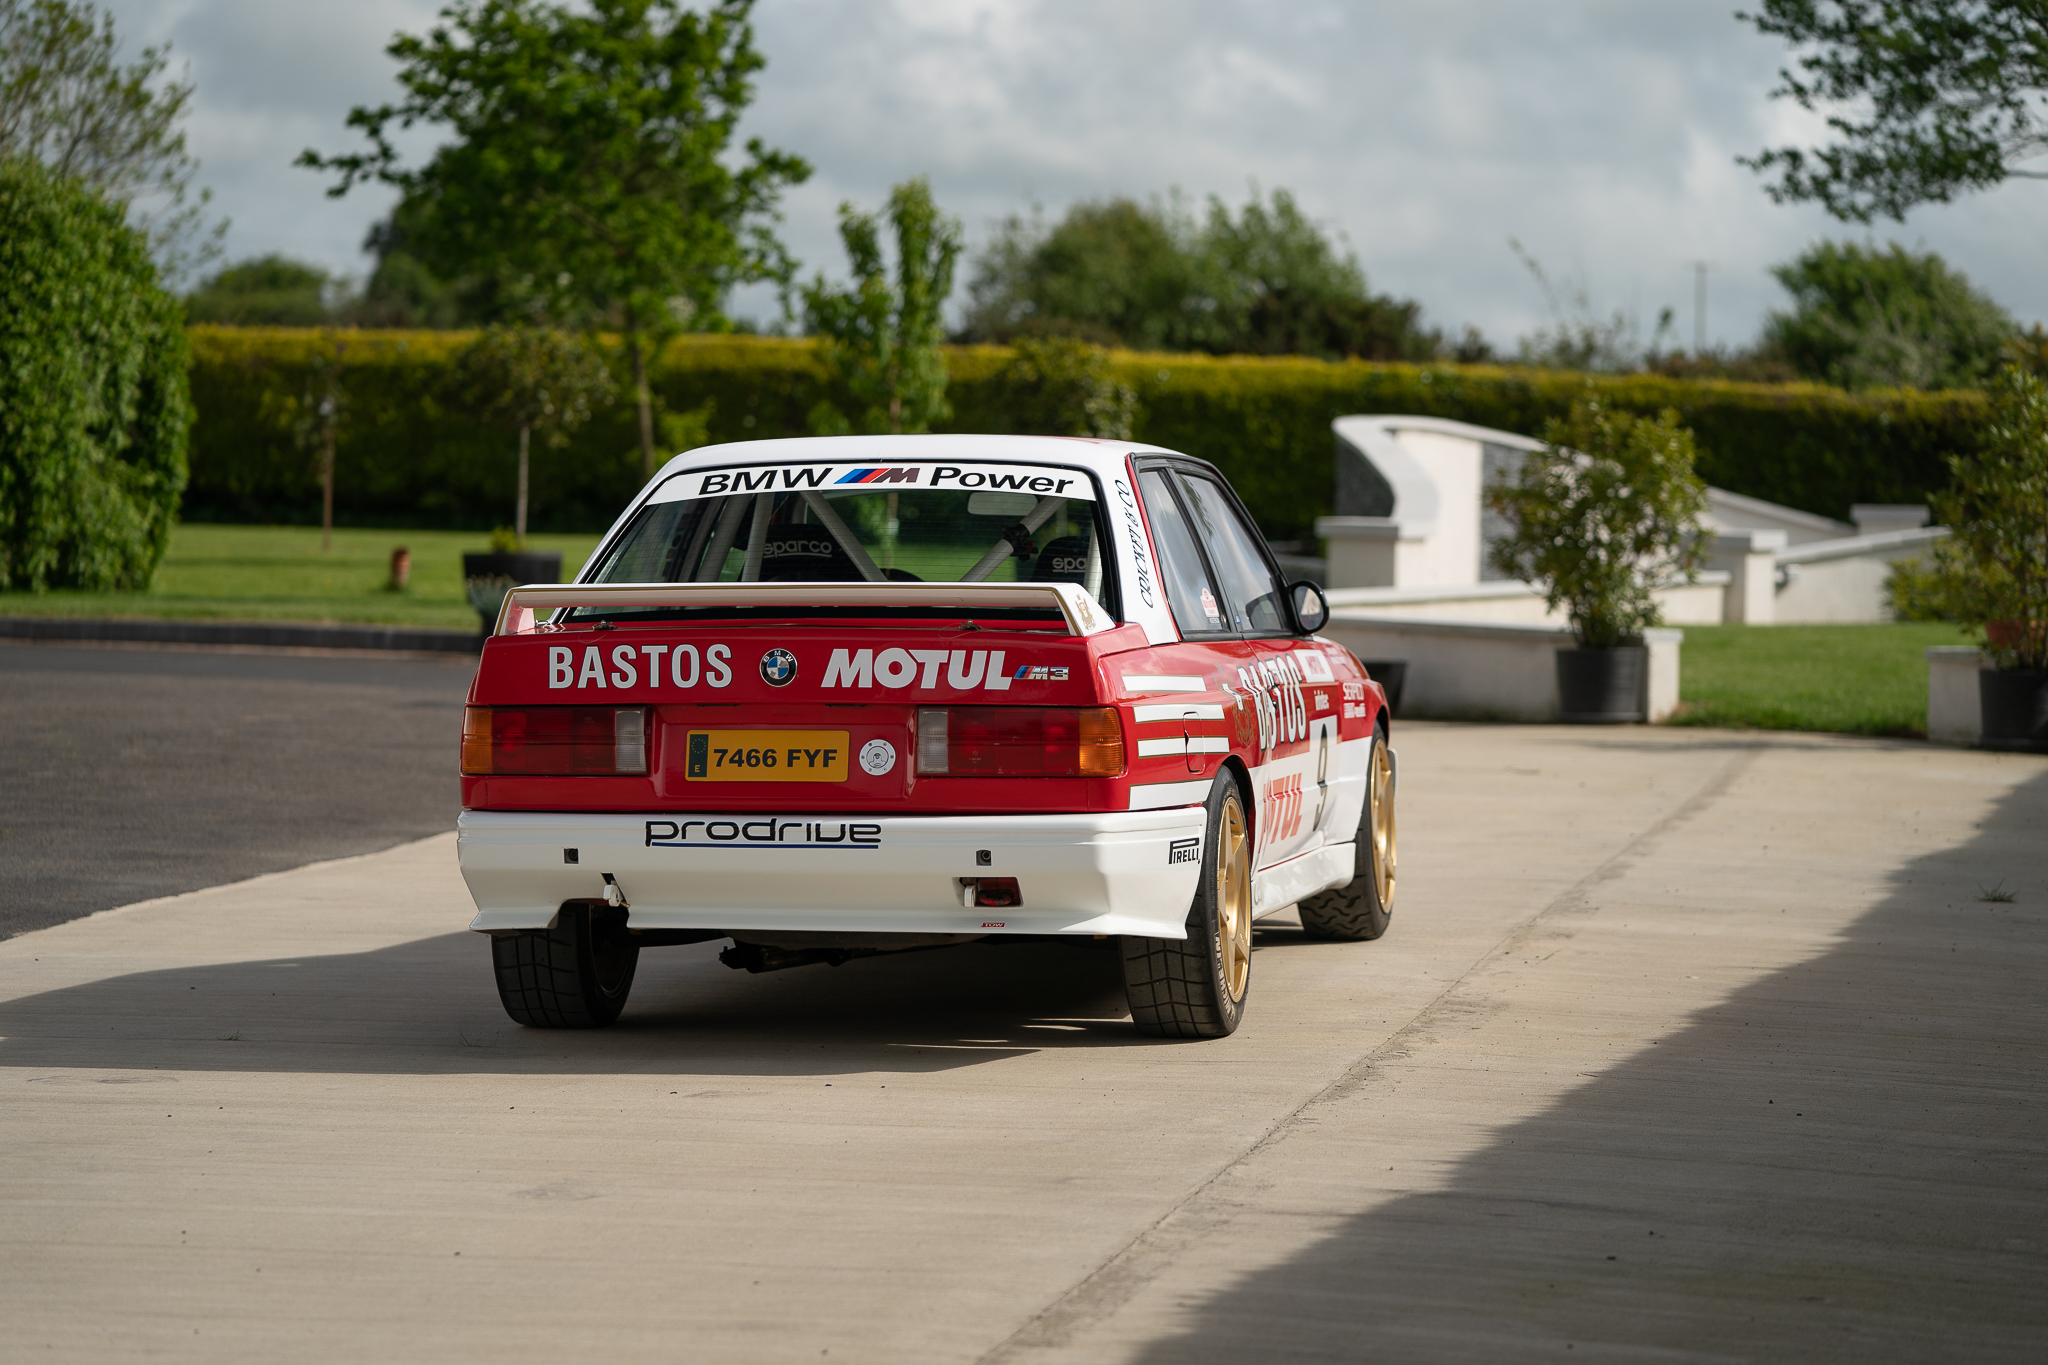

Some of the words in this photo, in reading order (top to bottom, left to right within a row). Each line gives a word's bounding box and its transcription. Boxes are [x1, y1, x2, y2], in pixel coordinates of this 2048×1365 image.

[699, 468, 834, 495] BMW
[930, 467, 1074, 493] Power
[1114, 479, 1133, 508] CO
[1124, 508, 1138, 528] &
[764, 540, 832, 558] sparco
[1052, 557, 1087, 573] spa
[1127, 525, 1153, 608] CRICKET
[549, 644, 733, 689] BASTOS
[763, 650, 793, 663] BMW
[821, 648, 1012, 690] MOTUL
[1028, 666, 1069, 680] M3
[713, 749, 777, 768] 7466
[787, 749, 838, 768] FYF
[1313, 723, 1328, 832] 9
[645, 818, 882, 848] prodrive
[1168, 837, 1200, 864] PIRELLI
